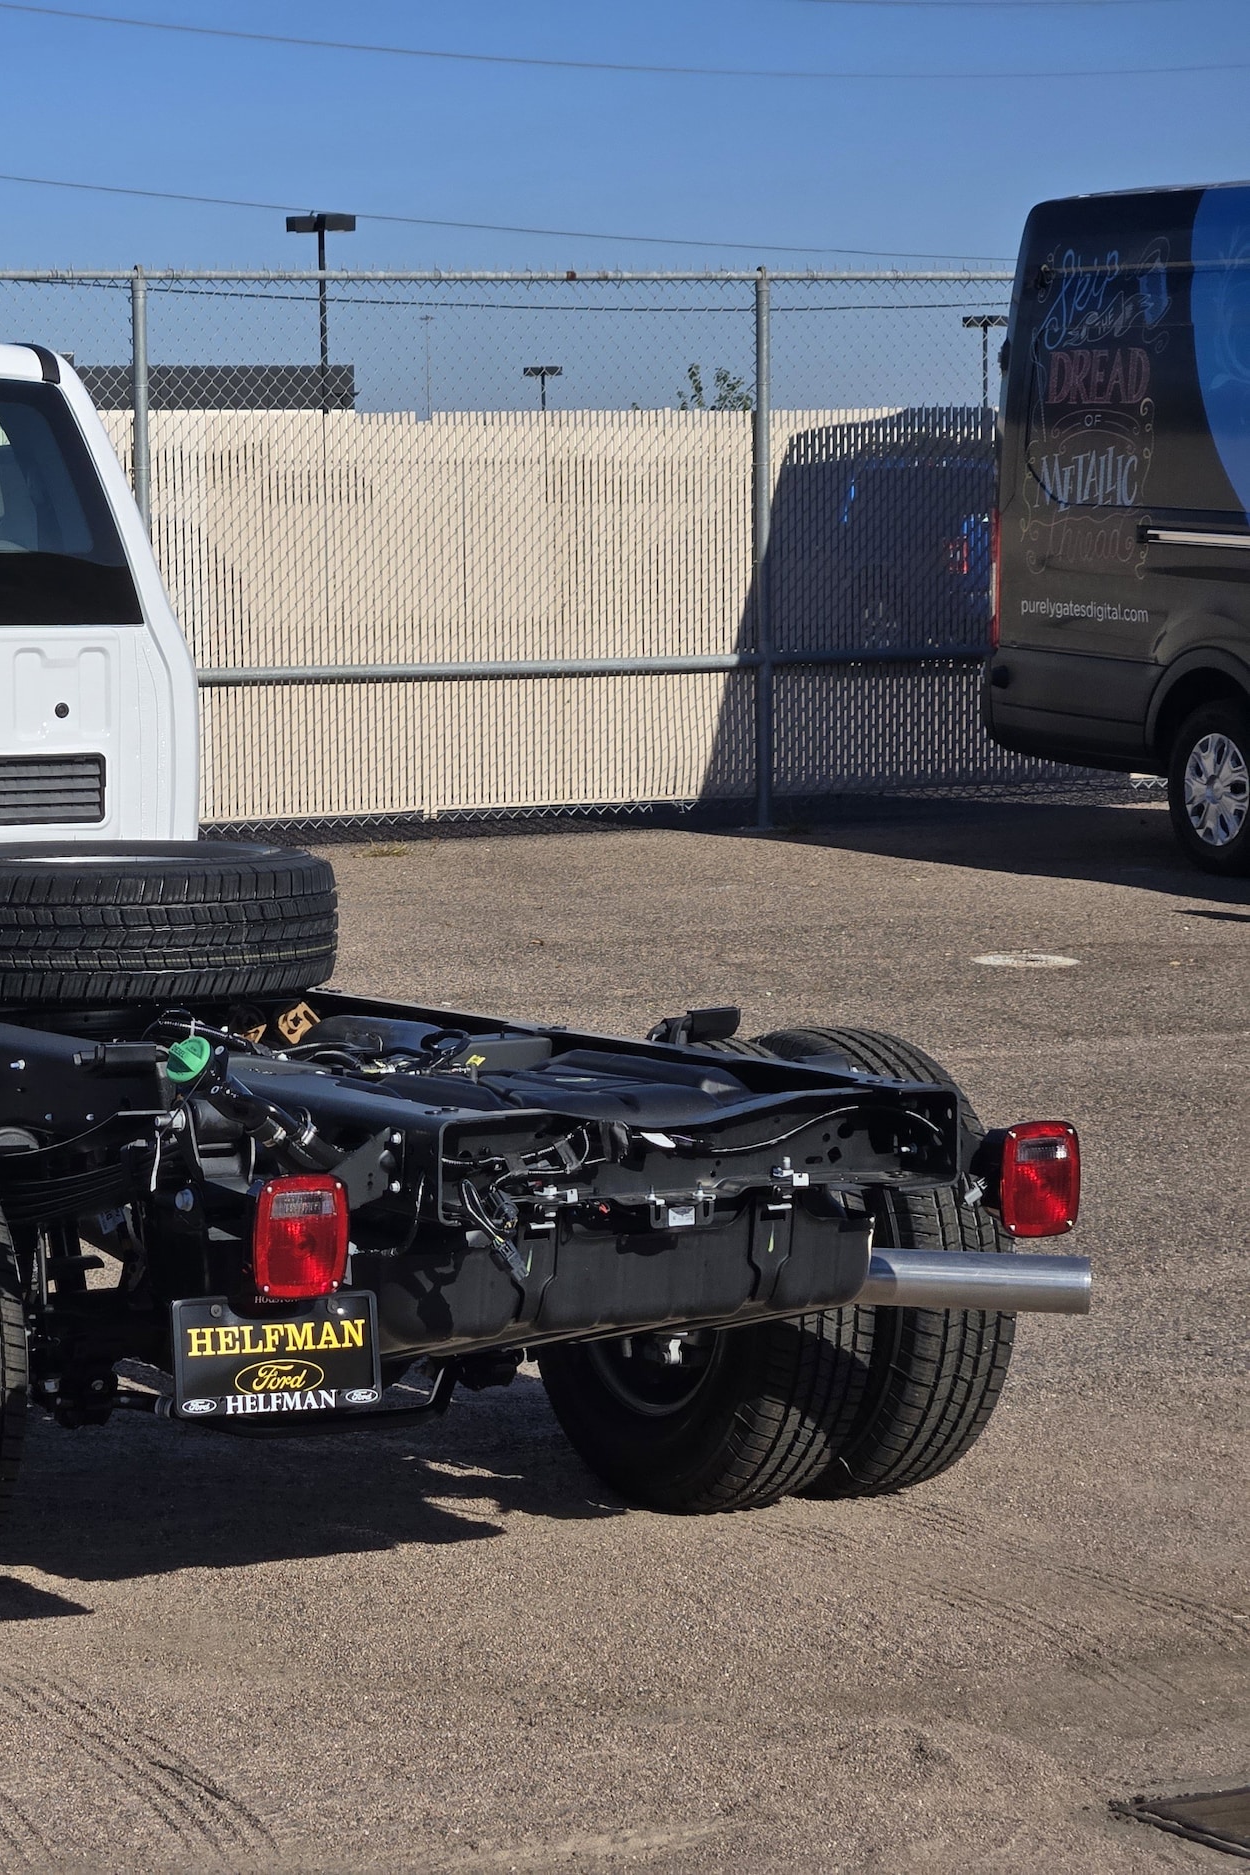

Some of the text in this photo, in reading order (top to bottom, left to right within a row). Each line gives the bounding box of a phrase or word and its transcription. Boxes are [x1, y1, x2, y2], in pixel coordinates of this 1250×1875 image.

[1037, 249, 1119, 349] Skip
[1045, 348, 1150, 404] DREAD
[1084, 414, 1102, 427] OF
[1033, 446, 1138, 512] METALLIC
[1021, 597, 1149, 623] purelygatesdigital.com
[187, 1319, 366, 1357] HELFMAN
[252, 1364, 308, 1391] Ford
[187, 1401, 211, 1412] Ford
[225, 1389, 339, 1415] HELFMAN
[351, 1391, 374, 1402] Ford
